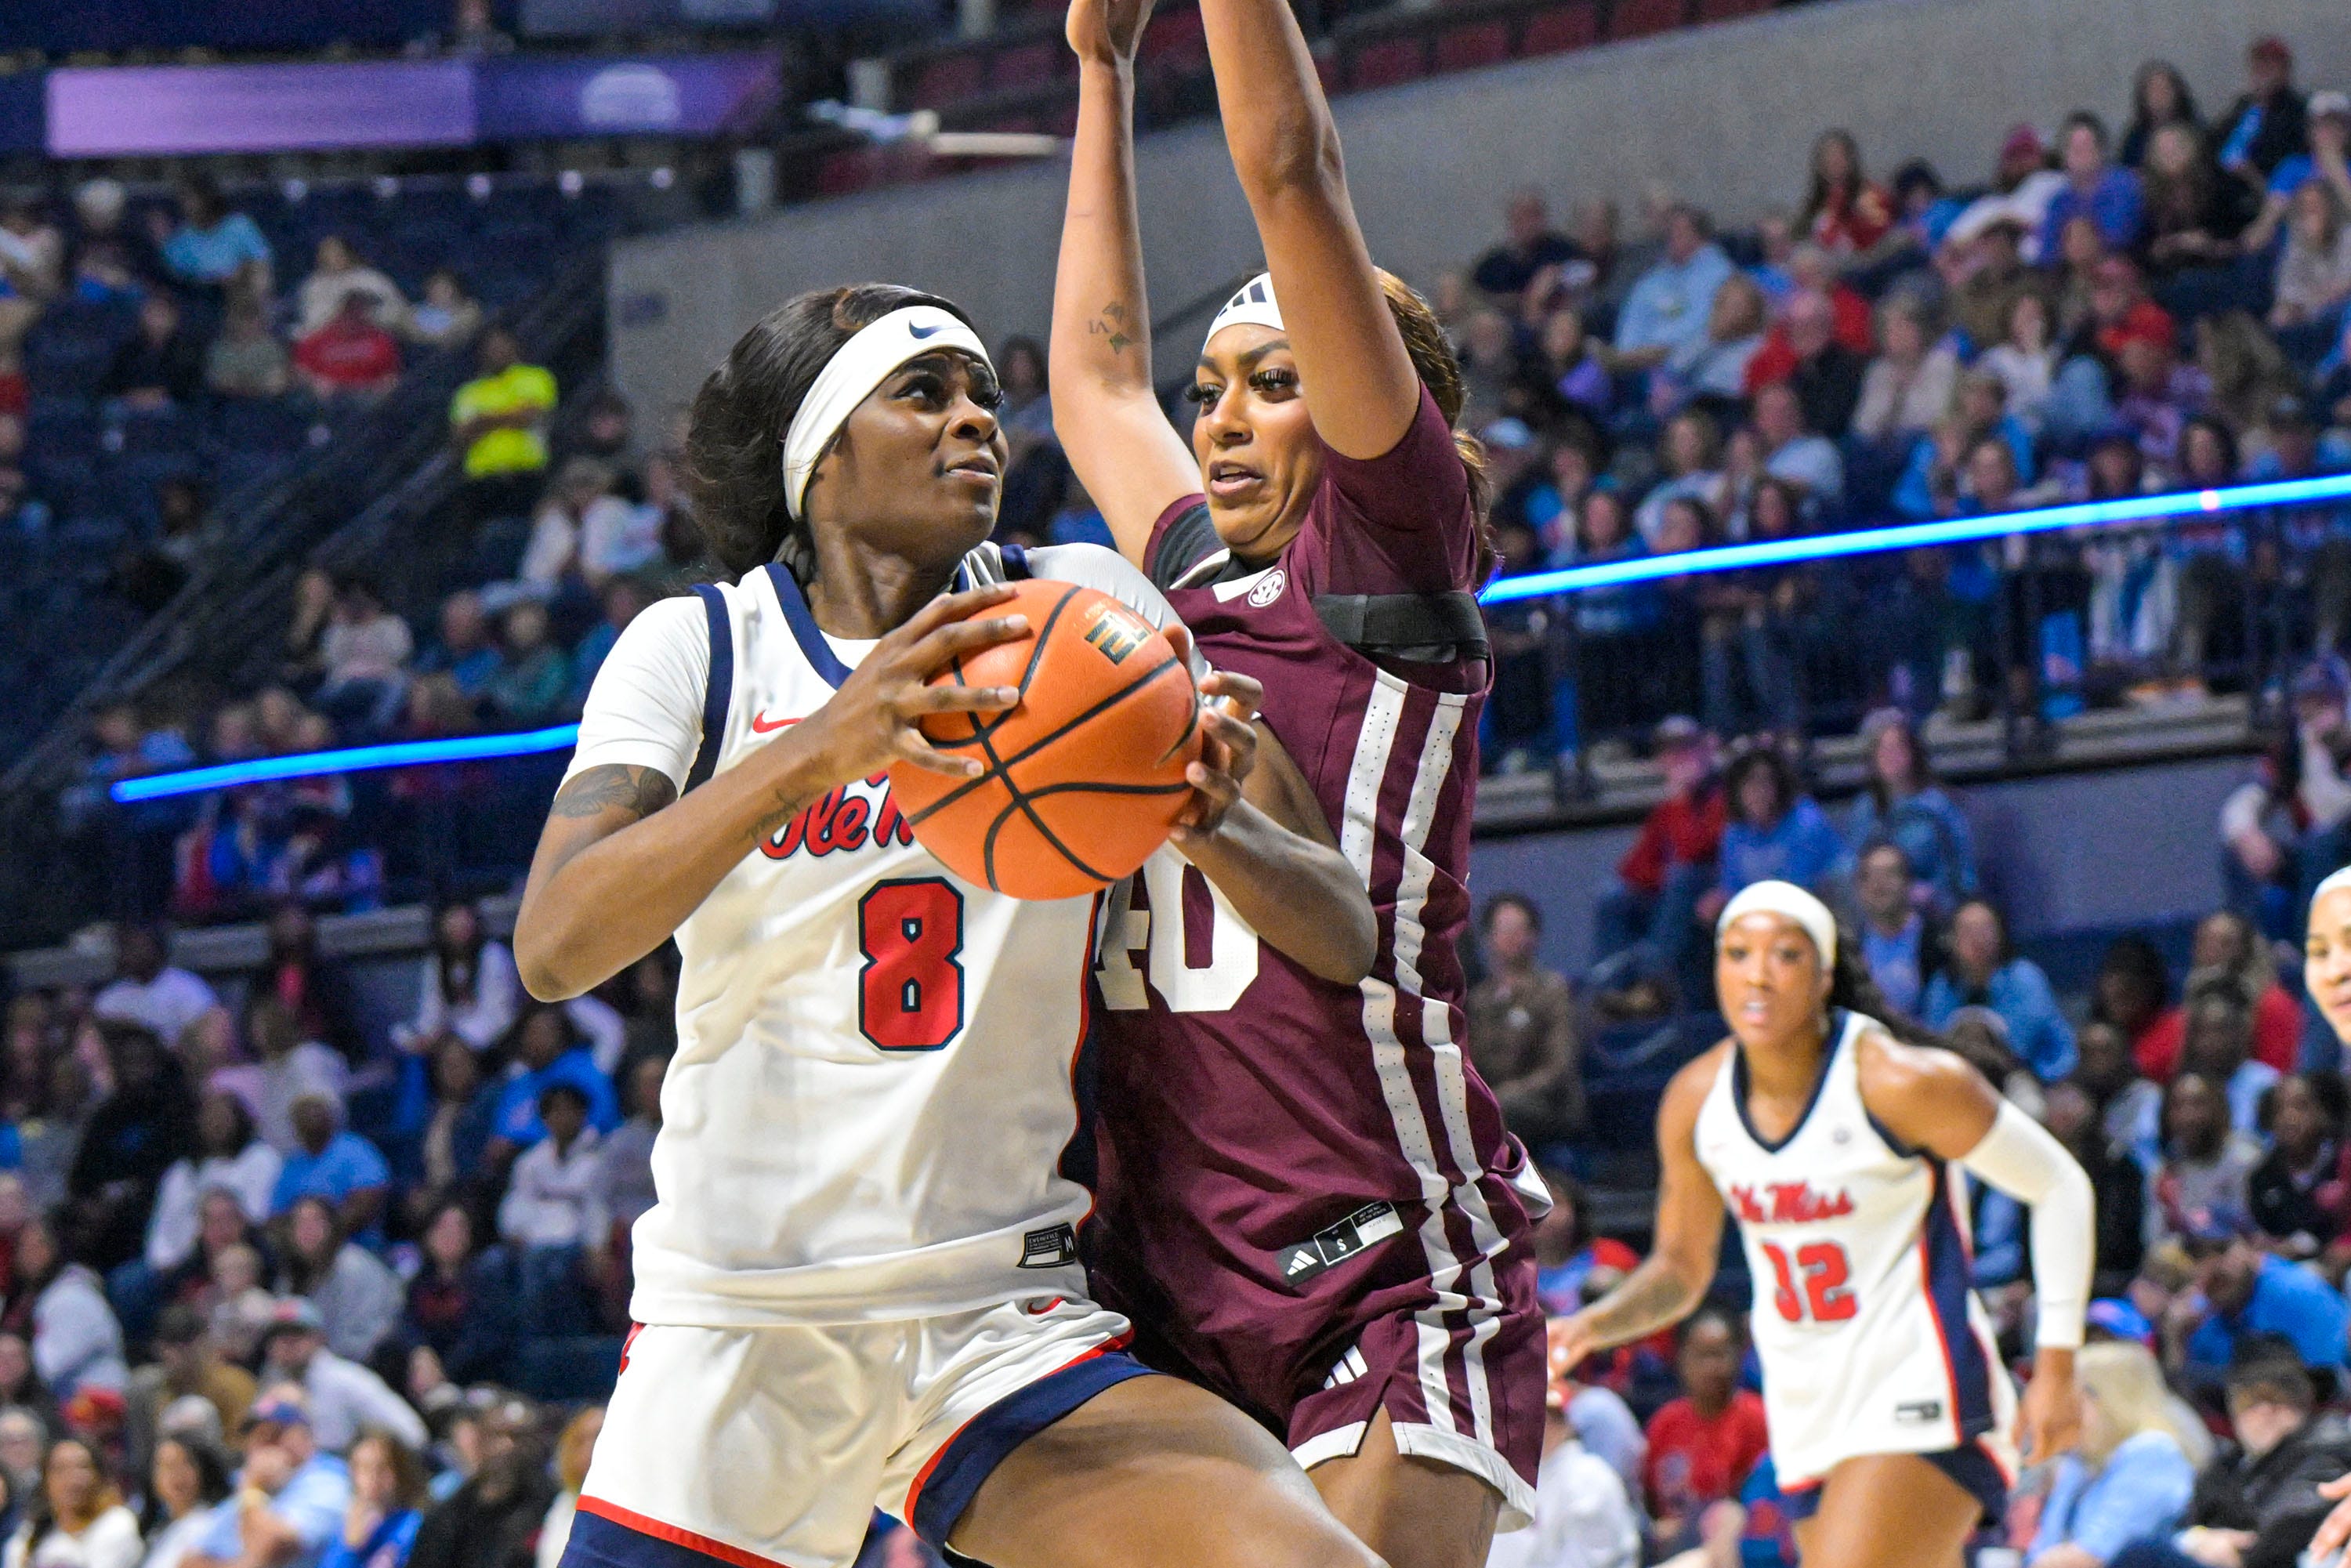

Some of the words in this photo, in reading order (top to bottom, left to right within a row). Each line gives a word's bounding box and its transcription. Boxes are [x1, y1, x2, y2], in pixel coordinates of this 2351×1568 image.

[858, 876, 965, 1052] 8
[1064, 1235, 1074, 1253] M
[1336, 1238, 1347, 1251] S
